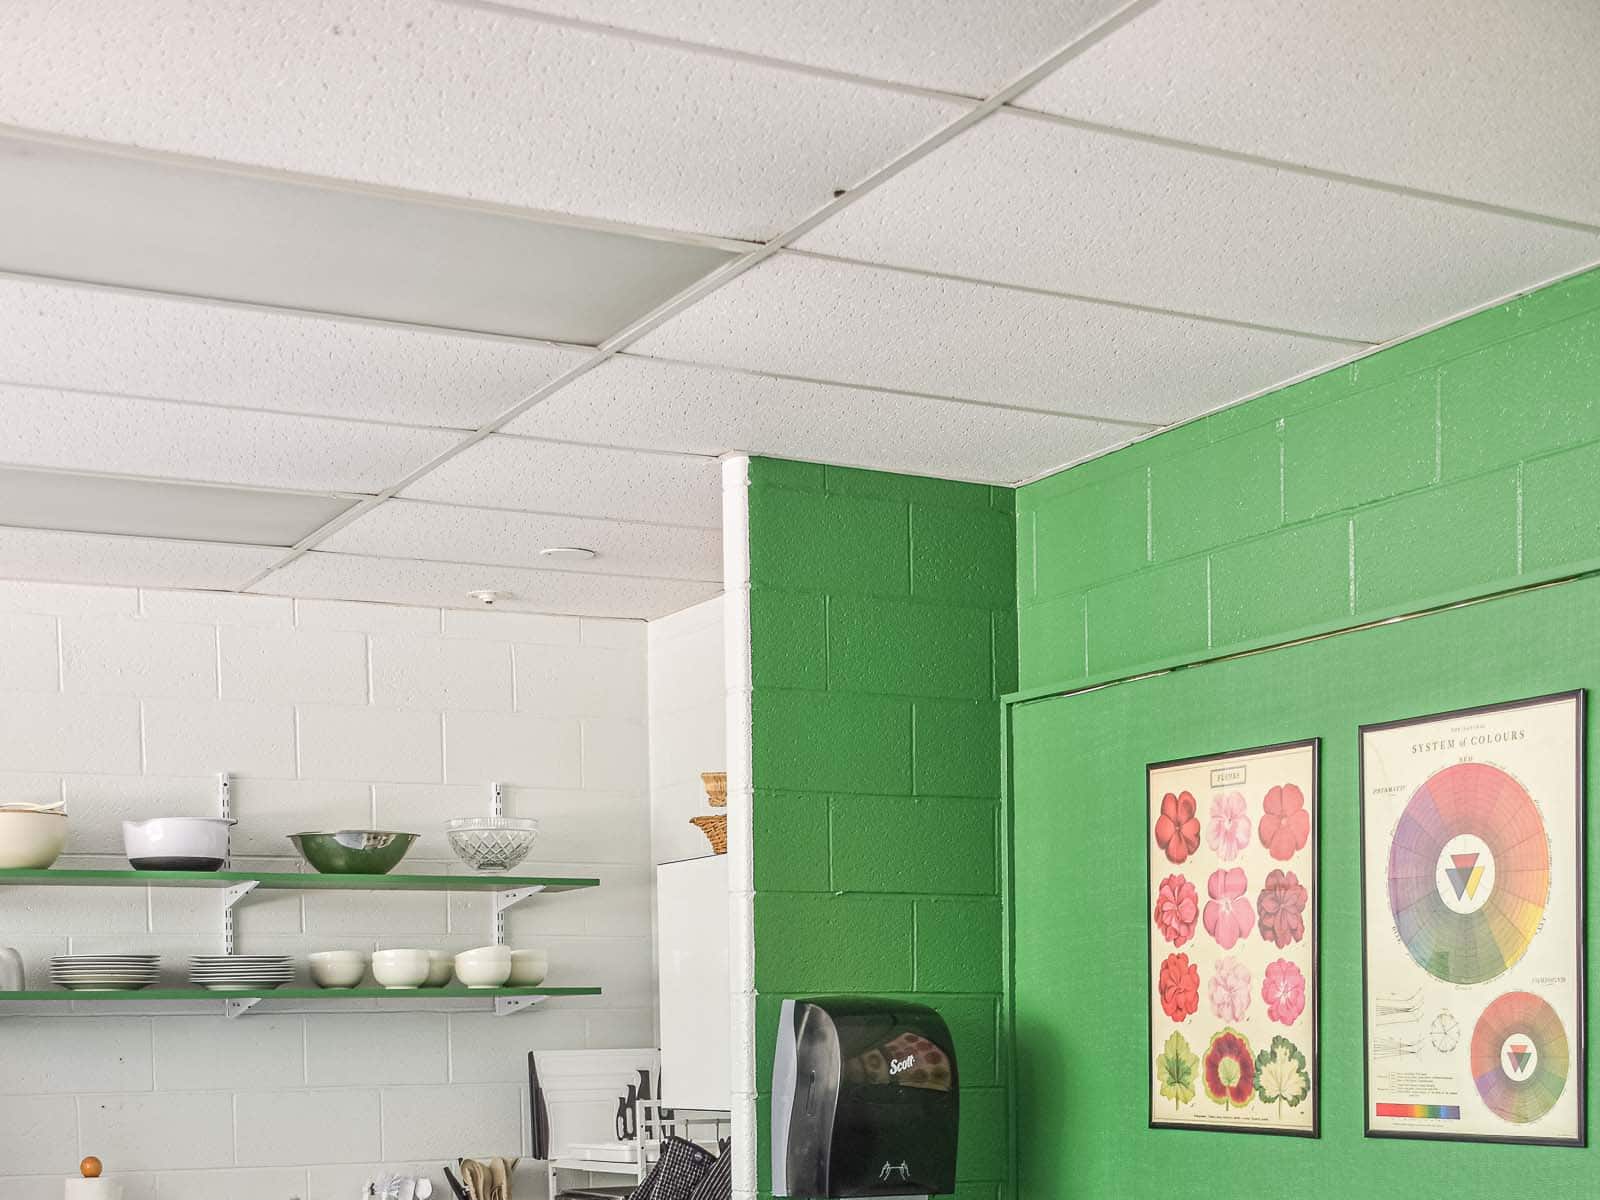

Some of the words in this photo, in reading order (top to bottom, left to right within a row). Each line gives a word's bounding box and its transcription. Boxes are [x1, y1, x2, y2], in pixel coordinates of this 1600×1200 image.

[1411, 739, 1455, 754] SYSTEM
[1459, 736, 1467, 748] of
[1470, 729, 1526, 746] COLOURS
[889, 1054, 914, 1075] Scott
